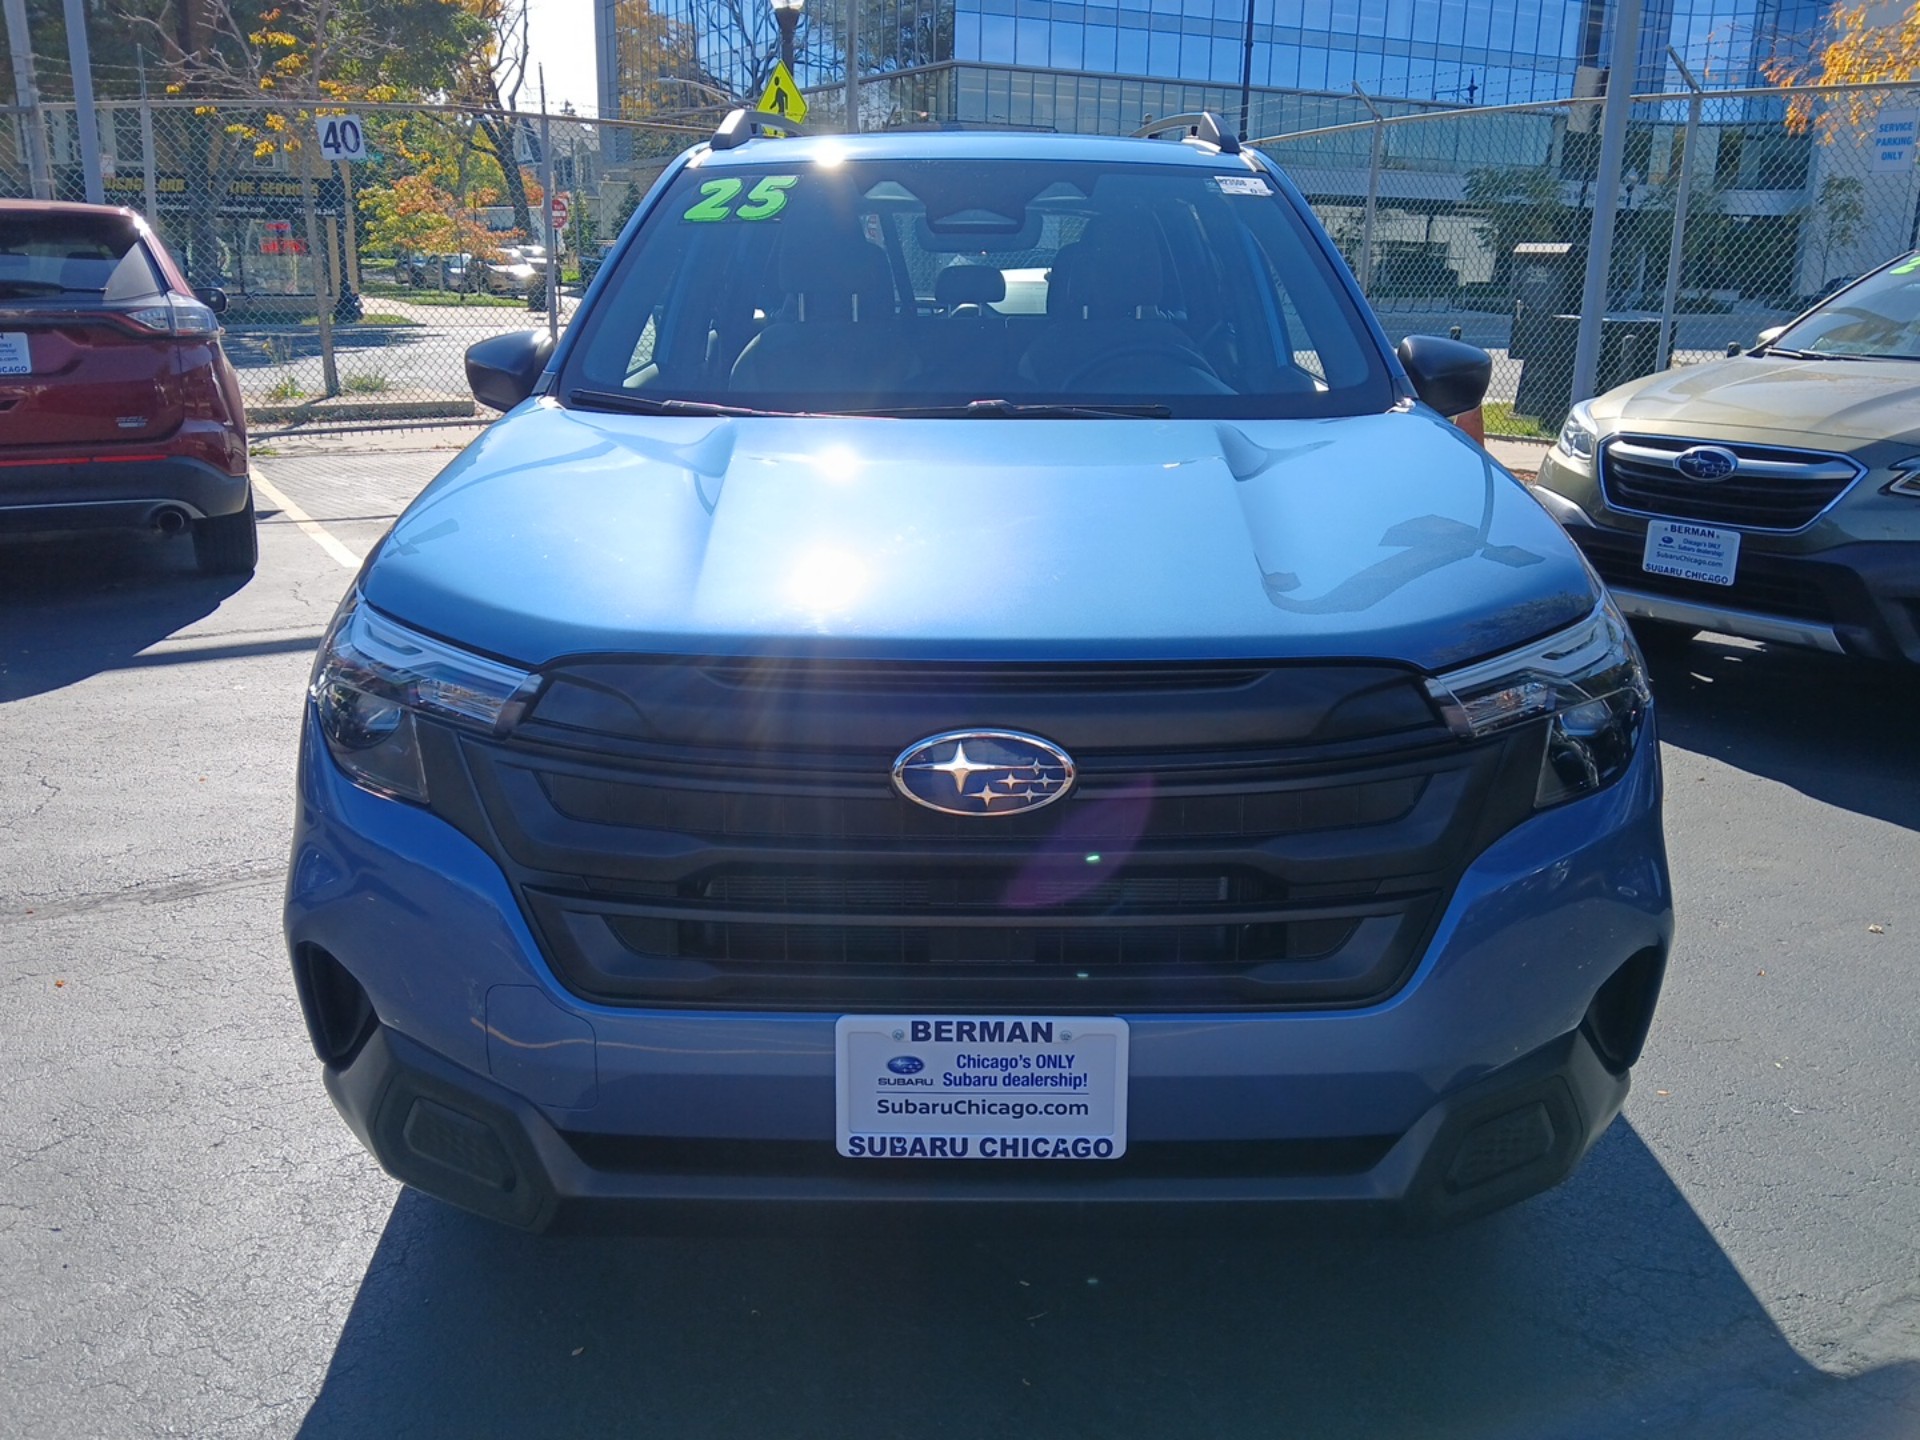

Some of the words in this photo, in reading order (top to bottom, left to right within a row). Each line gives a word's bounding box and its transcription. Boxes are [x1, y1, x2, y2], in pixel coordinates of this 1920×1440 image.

[1879, 121, 1913, 132] SERVICE
[323, 120, 360, 154] 40
[1876, 136, 1912, 146] PARKING
[1881, 151, 1903, 160] ONLY
[683, 175, 798, 222] 25
[1670, 524, 1715, 539] BERMAN
[1656, 551, 1723, 567] SubaruChicago.com
[1646, 563, 1682, 576] SUBARU
[1685, 570, 1728, 584] CHICAGO
[911, 1020, 1053, 1043] BERMAN
[956, 1054, 1031, 1071] Chicago's
[1036, 1054, 1075, 1069] ONLY
[878, 1077, 933, 1086] SUBARU
[943, 1072, 998, 1087] Subaru
[1002, 1073, 1088, 1090] dealership!
[877, 1099, 1089, 1119] SubaruChicago.com
[848, 1136, 968, 1157] SUBARU
[979, 1137, 1113, 1158] CHICAGO
